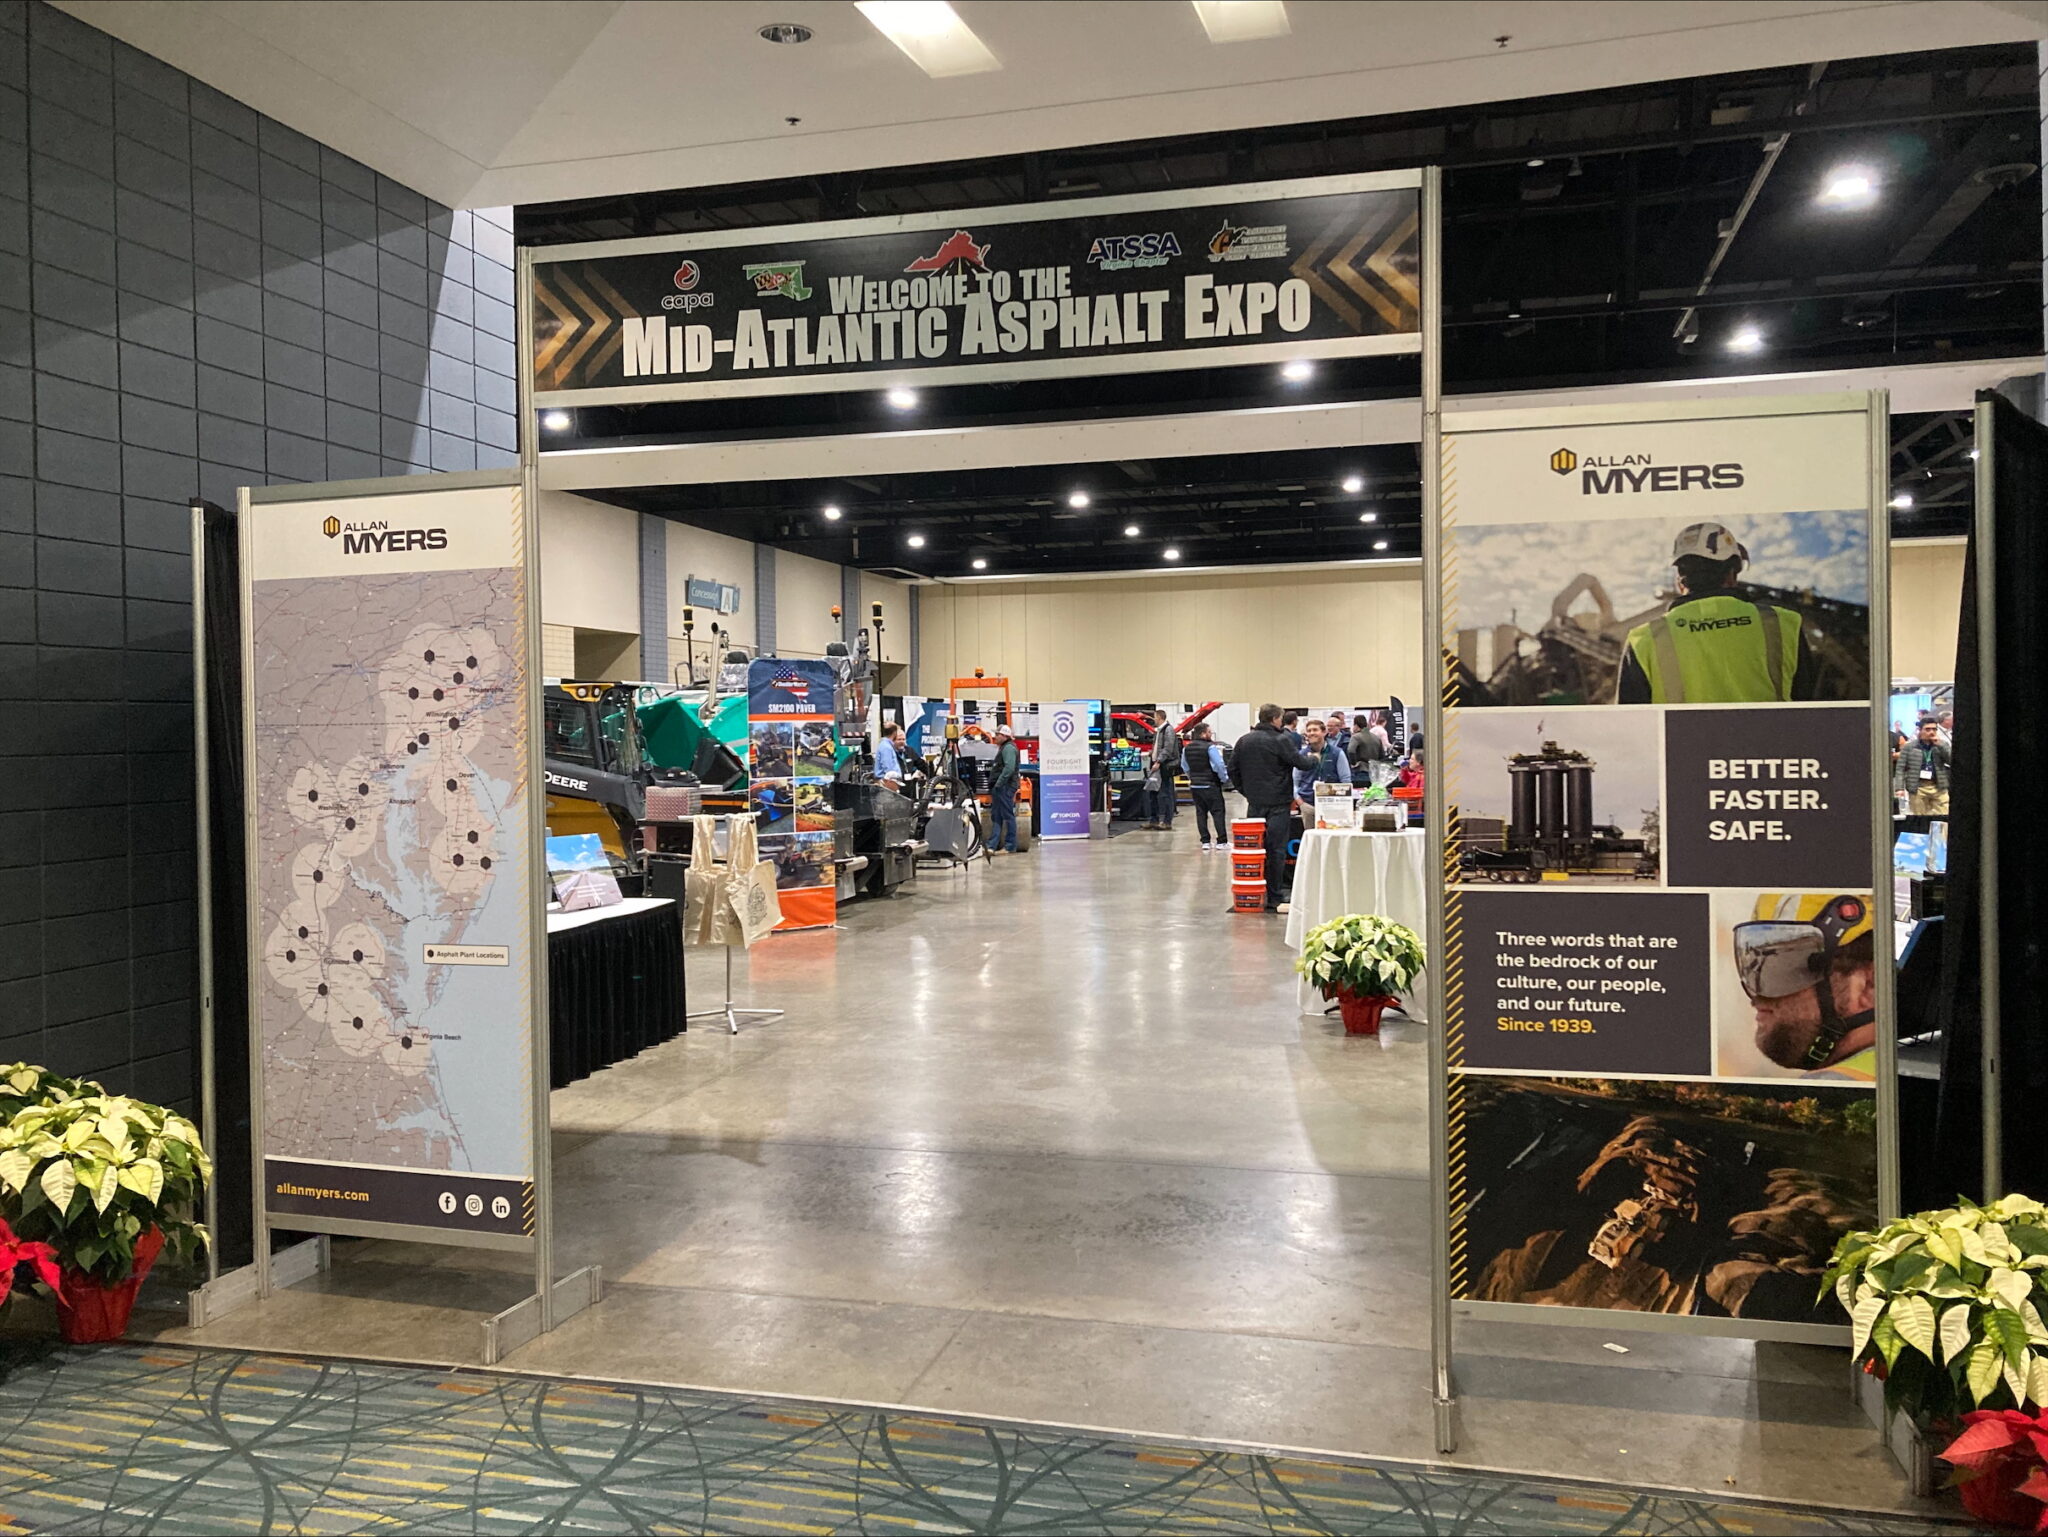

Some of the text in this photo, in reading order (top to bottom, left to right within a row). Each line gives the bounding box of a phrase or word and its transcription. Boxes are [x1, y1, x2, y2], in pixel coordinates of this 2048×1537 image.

[1087, 232, 1182, 263] ATSSA
[975, 271, 1011, 303] TO
[1019, 266, 1071, 300] THE
[661, 292, 714, 314] capa
[961, 290, 1169, 357] ASPHALT
[1184, 274, 1311, 340] EXPO
[1583, 454, 1652, 468] ALLAN
[1582, 463, 1744, 495] MYERS
[343, 520, 388, 533] ALLAN
[343, 528, 448, 555] MYERS
[1689, 616, 1752, 632] MYERS
[426, 711, 457, 719] Wilmington
[796, 703, 816, 714] PAVER
[1708, 758, 1829, 779] BETTER.
[1708, 789, 1829, 810] FASTER.
[1708, 820, 1792, 841] SAFE.
[1496, 931, 1678, 949] Three words that are
[1496, 953, 1658, 970] the bedrock of our
[1496, 974, 1666, 994] culture, our people,
[1496, 996, 1626, 1013] and our future.
[1497, 1016, 1597, 1034] Since 1939.
[276, 1183, 369, 1201] allanmyers.com
